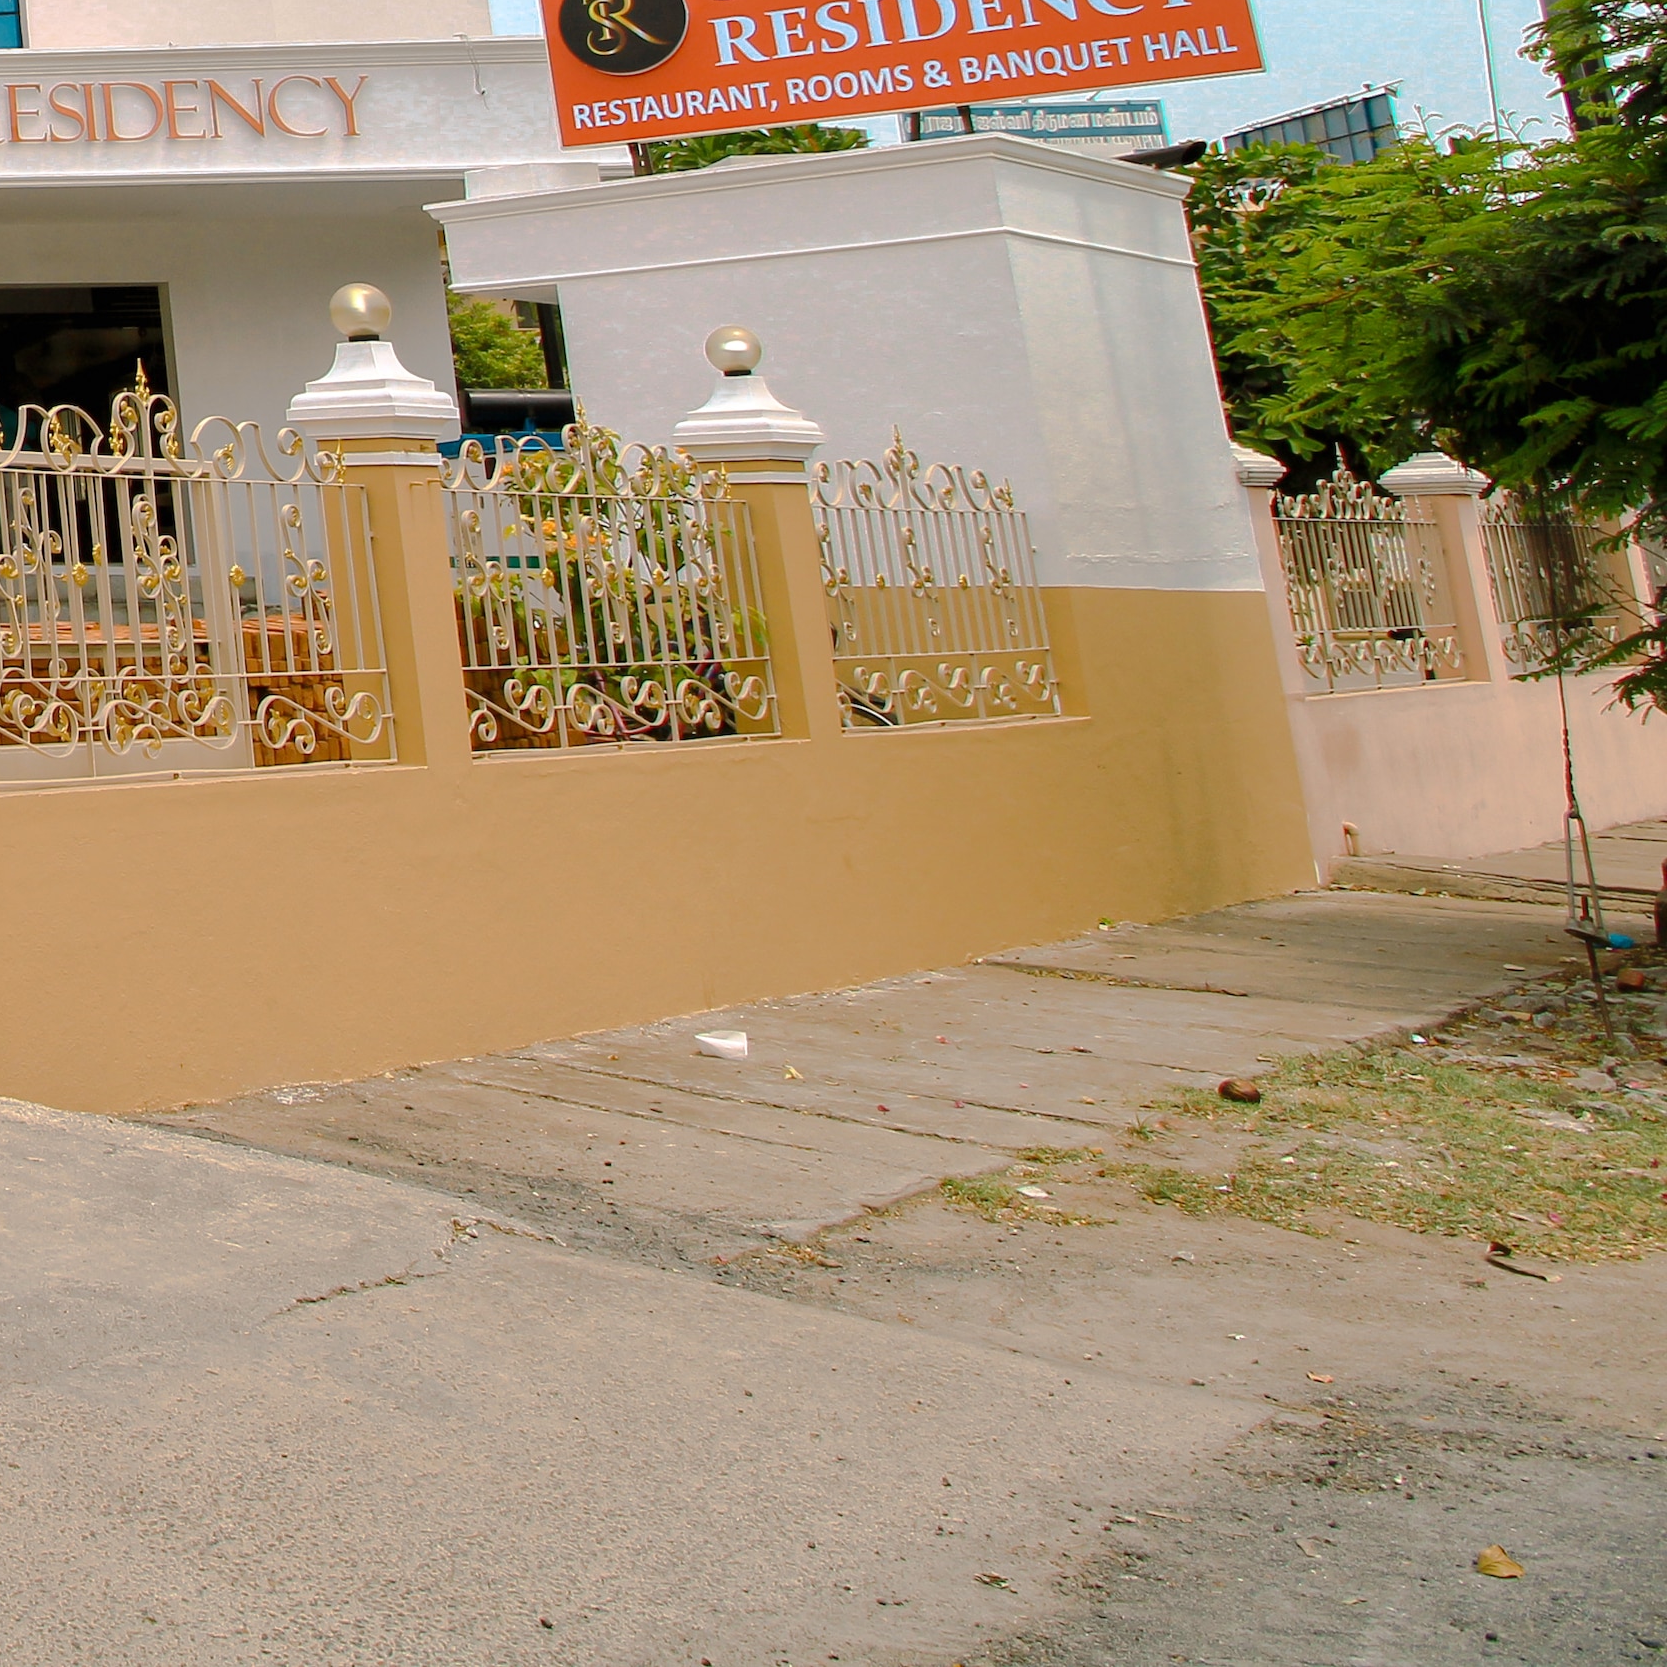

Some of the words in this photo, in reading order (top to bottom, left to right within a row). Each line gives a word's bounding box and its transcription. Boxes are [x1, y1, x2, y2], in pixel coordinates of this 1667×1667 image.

[572, 82, 779, 130] RESTAURANT,
[786, 65, 914, 104] ROOMS
[922, 60, 952, 89] &
[958, 37, 1132, 85] BANQUET
[1143, 24, 1238, 62] HALL
